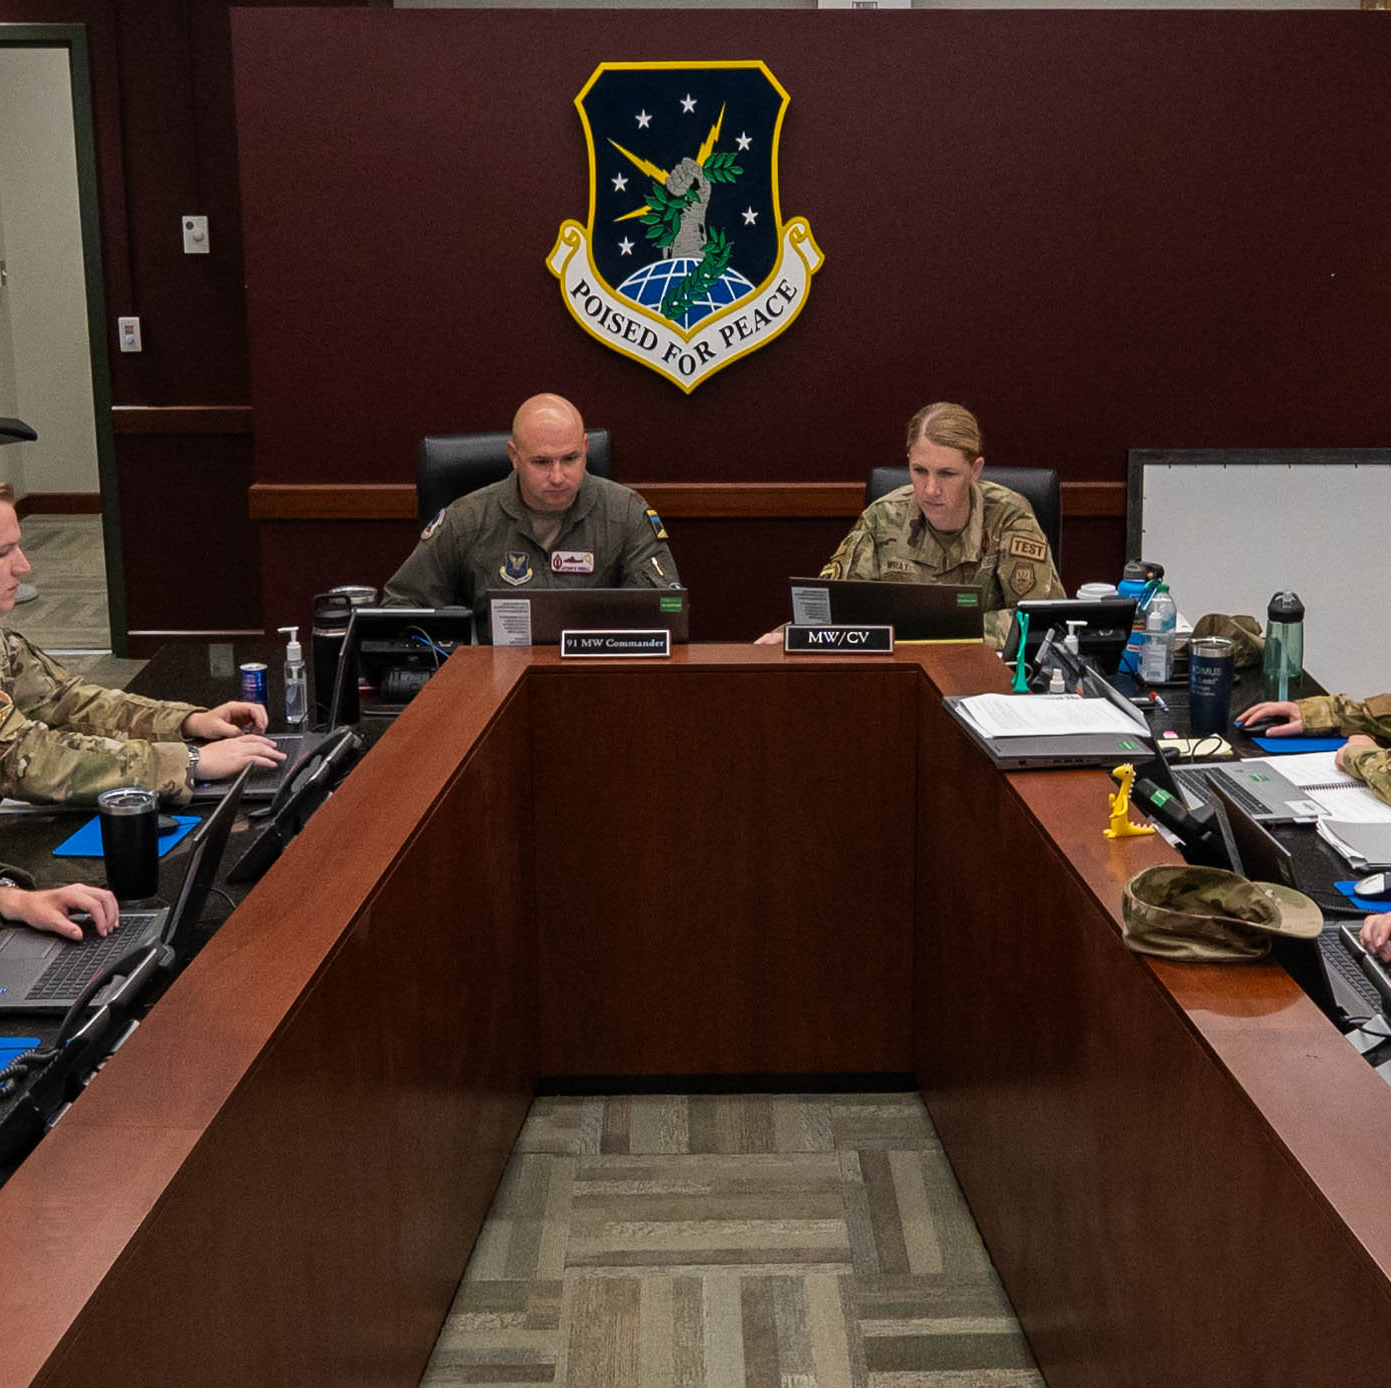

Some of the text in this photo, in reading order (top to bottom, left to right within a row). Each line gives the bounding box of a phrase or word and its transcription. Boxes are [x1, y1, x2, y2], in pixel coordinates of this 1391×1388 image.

[570, 278, 798, 376] POISED FOR PEACE
[1013, 539, 1044, 557] TEST
[886, 560, 909, 571] WRAY
[566, 638, 664, 648] 91 MW Commander
[808, 631, 870, 645] MW/CV
